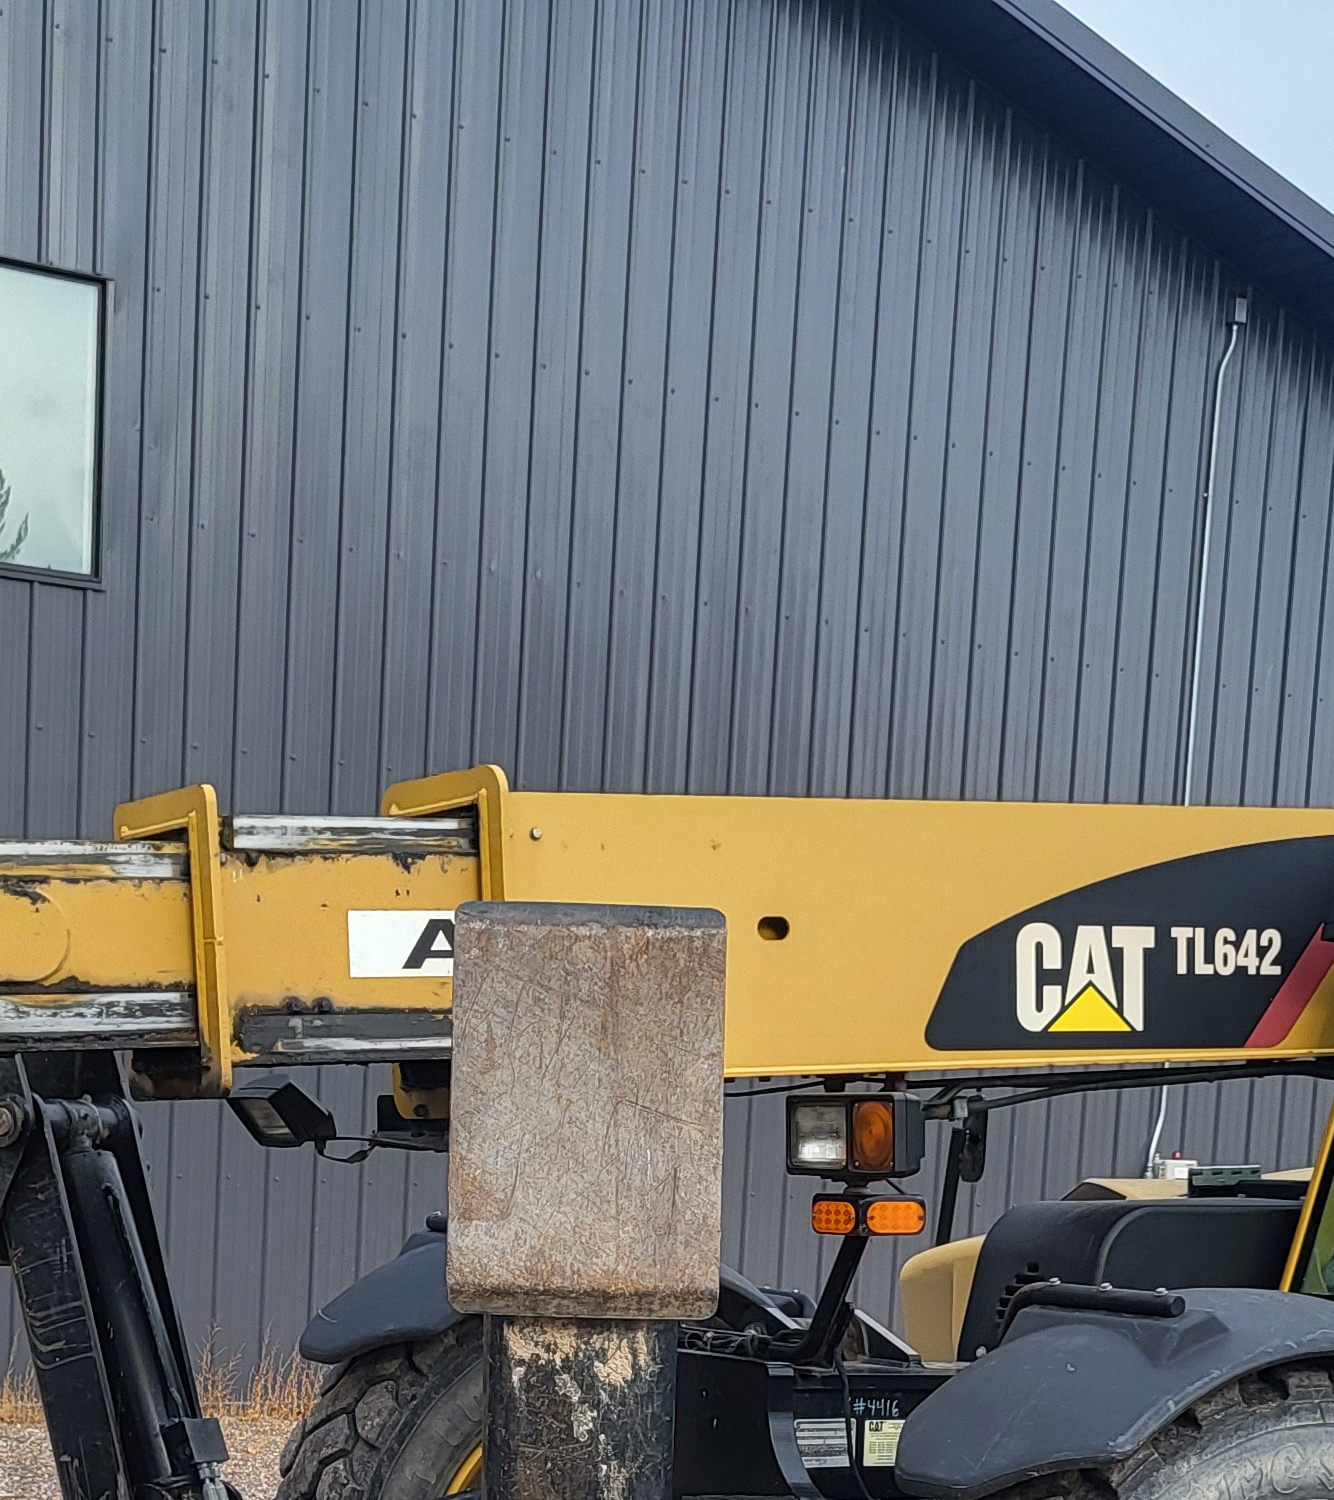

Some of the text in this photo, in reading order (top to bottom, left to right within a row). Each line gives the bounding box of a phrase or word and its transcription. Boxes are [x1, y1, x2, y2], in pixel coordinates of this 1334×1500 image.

[1015, 922, 1283, 1032] CAT TL642
[853, 1397, 899, 1417] #4416
[869, 1421, 884, 1432] CAT
